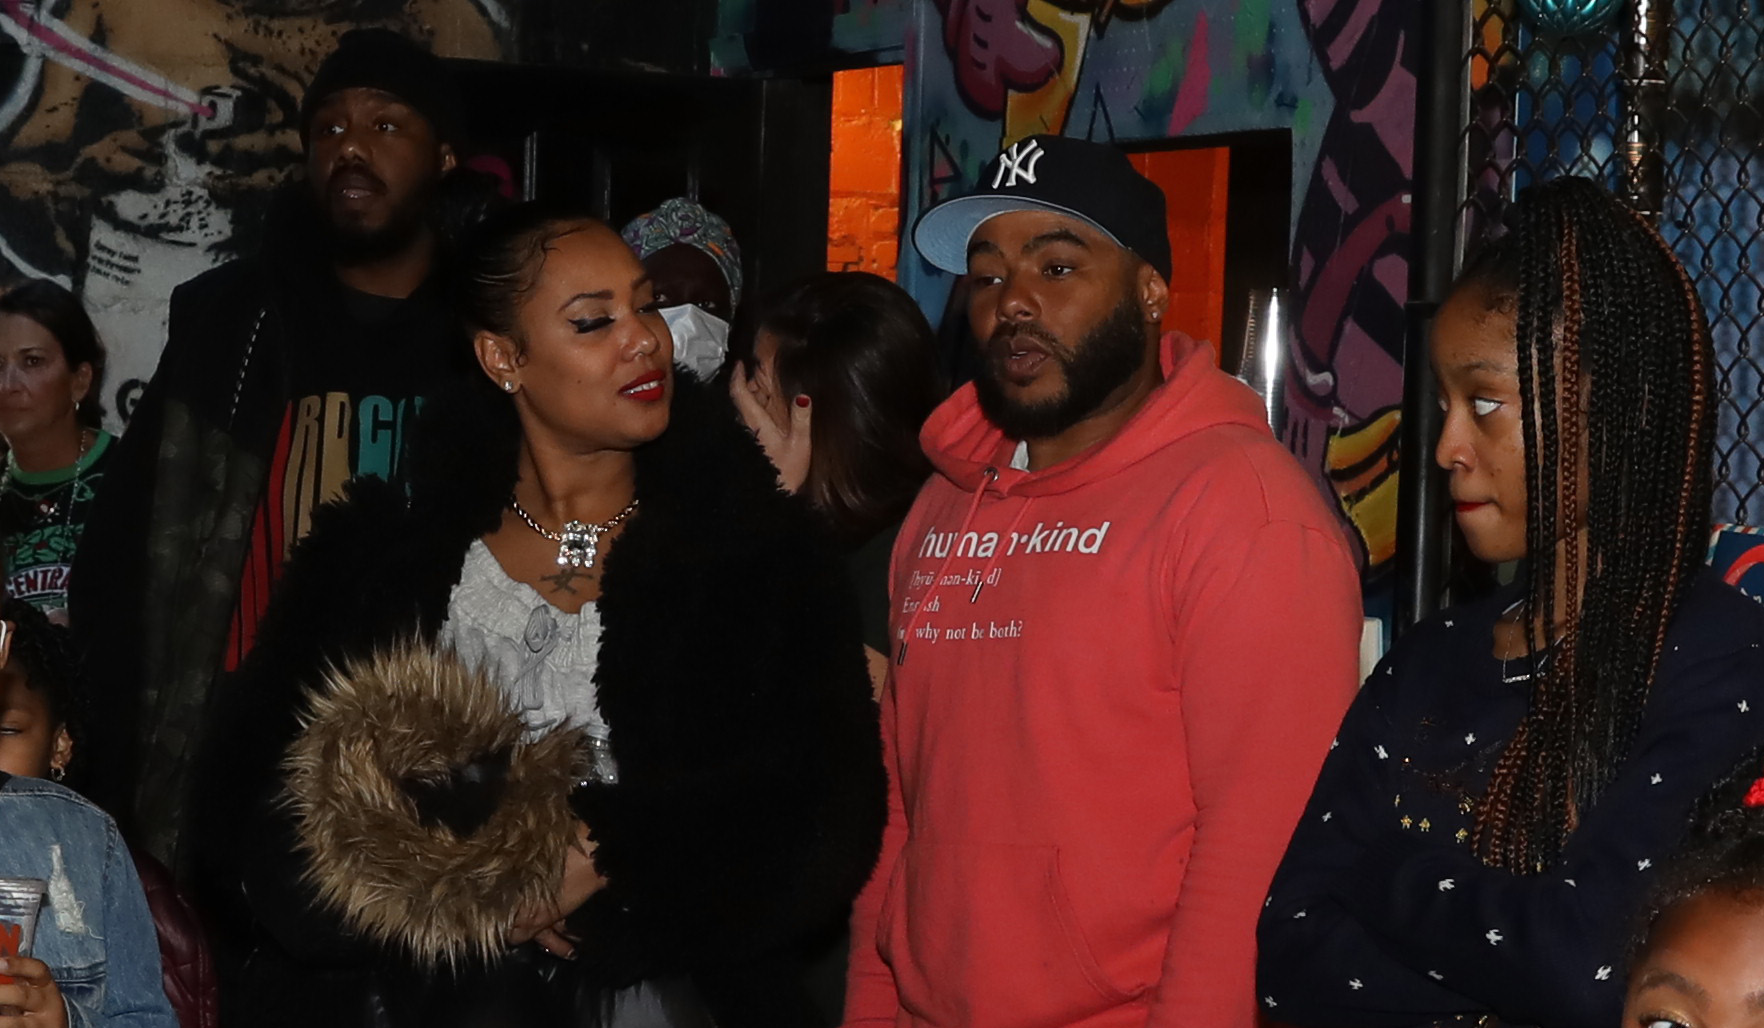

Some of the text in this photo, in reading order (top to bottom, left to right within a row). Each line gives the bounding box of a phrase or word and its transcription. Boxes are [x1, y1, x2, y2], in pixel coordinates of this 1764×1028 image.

[991, 139, 1045, 190] NY
[915, 621, 941, 645] why
[945, 626, 967, 640] not
[971, 621, 984, 640] be
[989, 619, 1023, 639] both?
